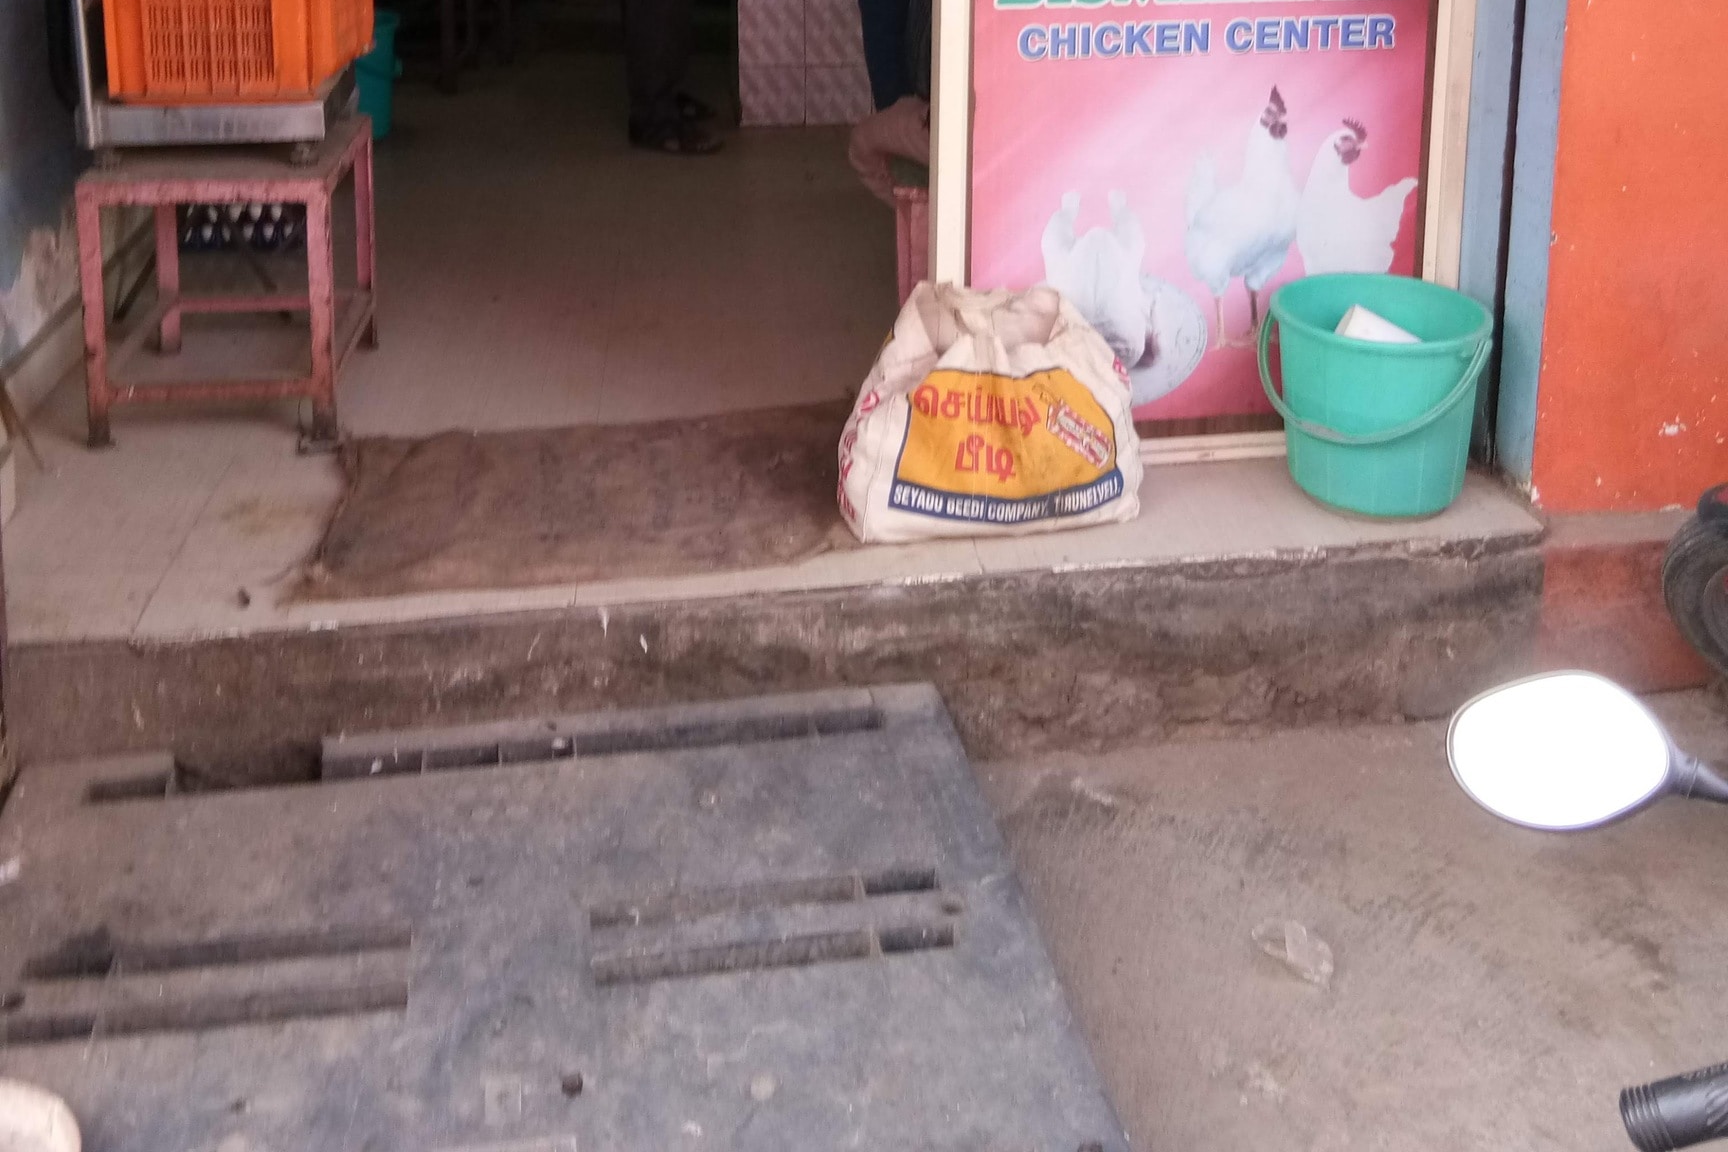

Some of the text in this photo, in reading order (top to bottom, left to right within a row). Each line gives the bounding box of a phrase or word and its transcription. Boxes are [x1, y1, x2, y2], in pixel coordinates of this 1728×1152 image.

[1018, 15, 1396, 61] CHICKEN CENTER
[955, 435, 1016, 482] பீடி
[894, 483, 943, 512] SEYADU
[946, 496, 984, 518] BEEDI
